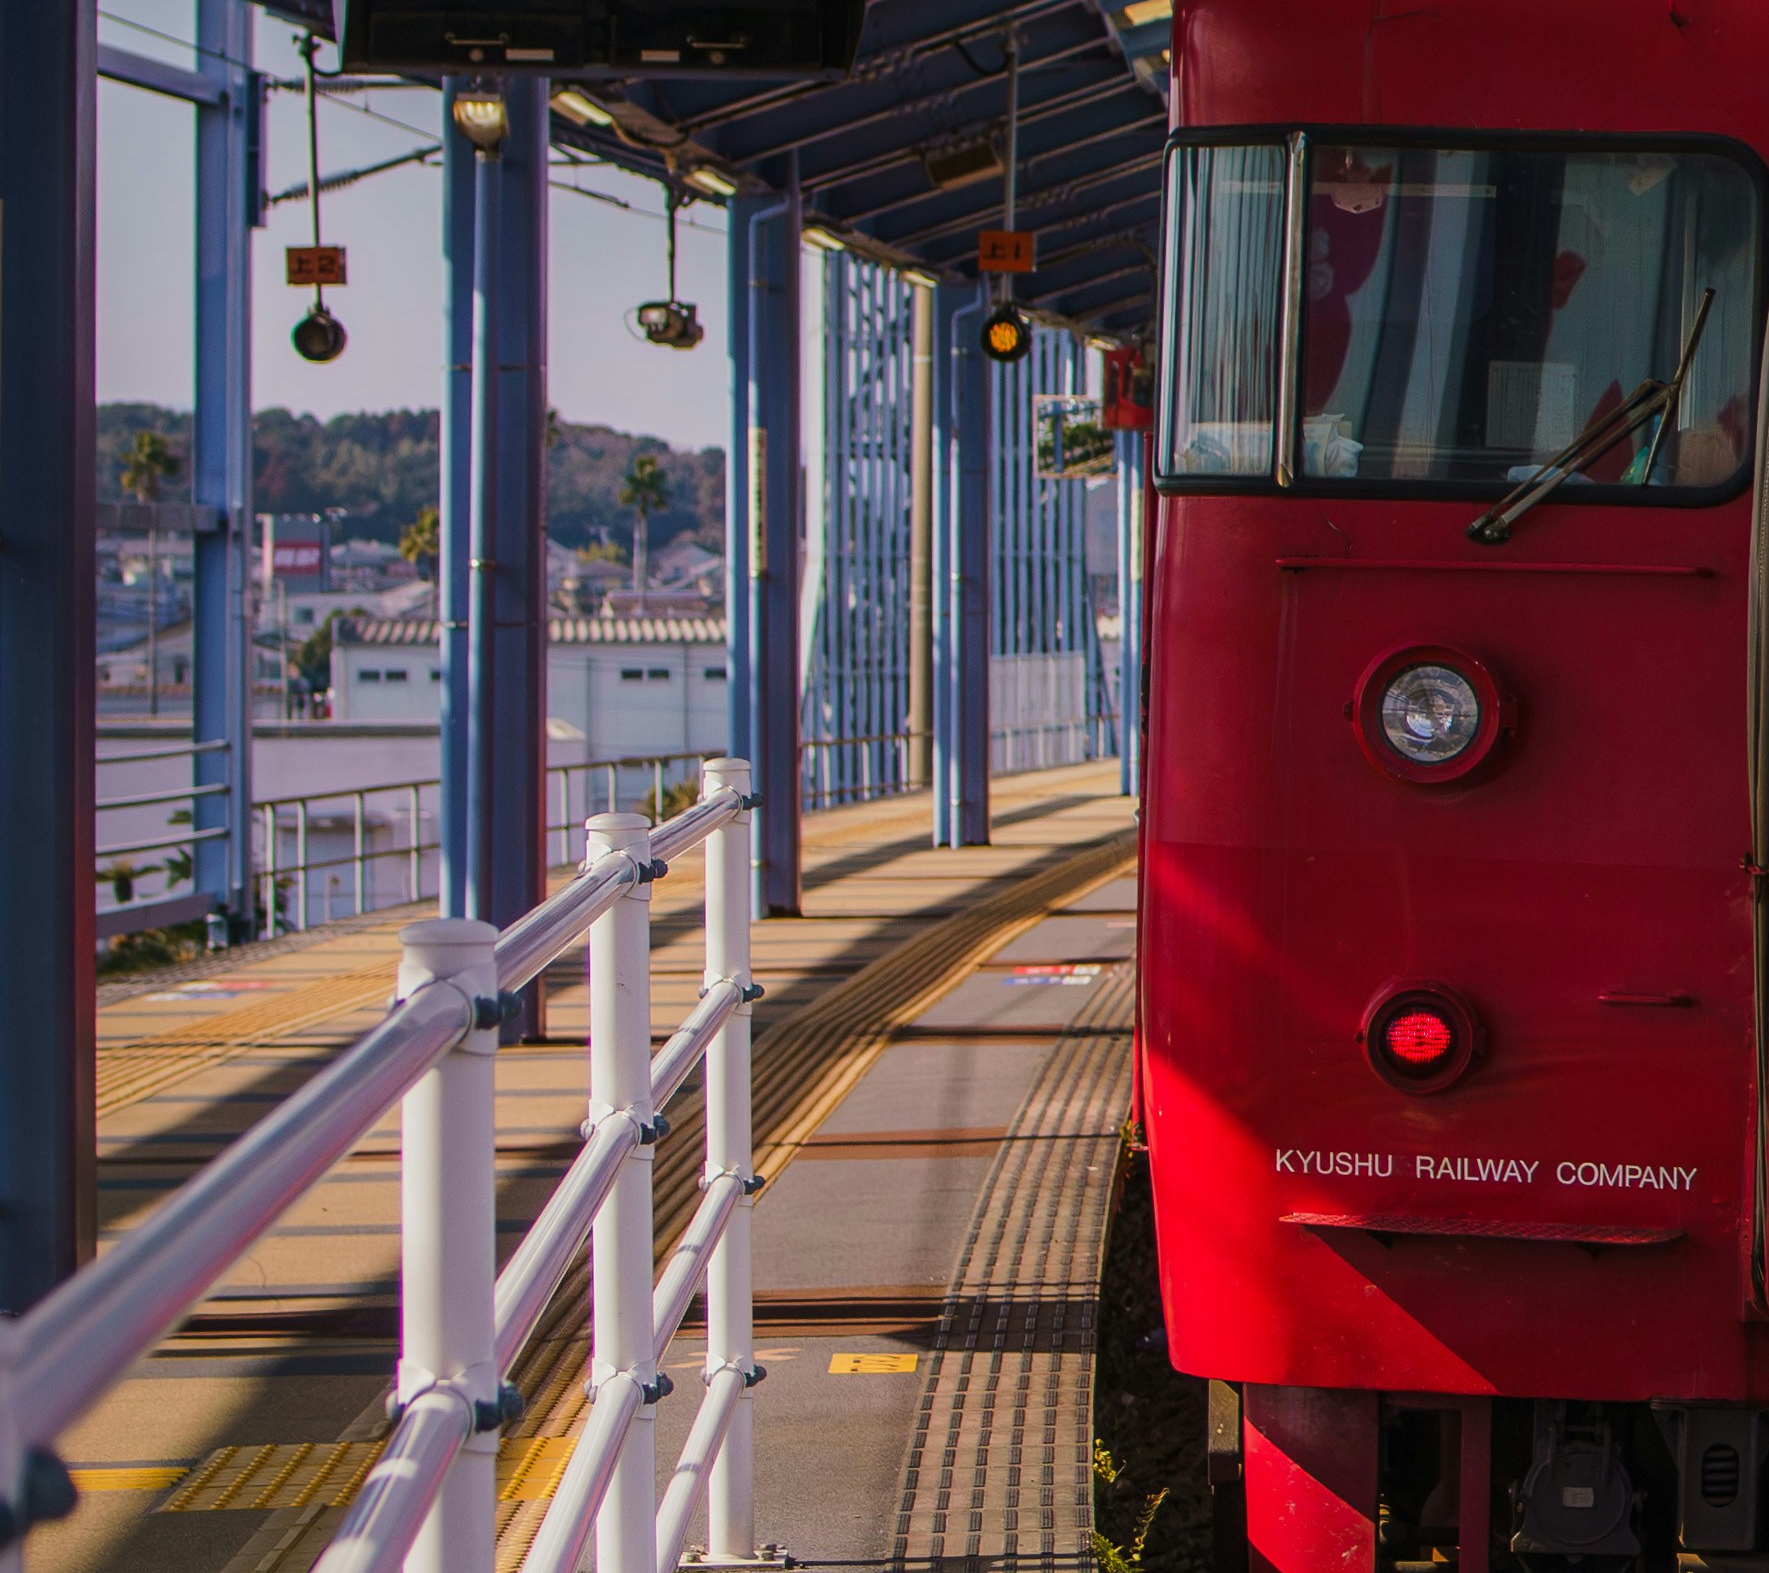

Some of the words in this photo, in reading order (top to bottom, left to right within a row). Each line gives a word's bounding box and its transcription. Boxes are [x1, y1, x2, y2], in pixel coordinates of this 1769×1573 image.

[1275, 1149, 1393, 1178] KYUSHU
[1415, 1155, 1540, 1184] RAILWAY
[1556, 1161, 1698, 1191] COMPANY
